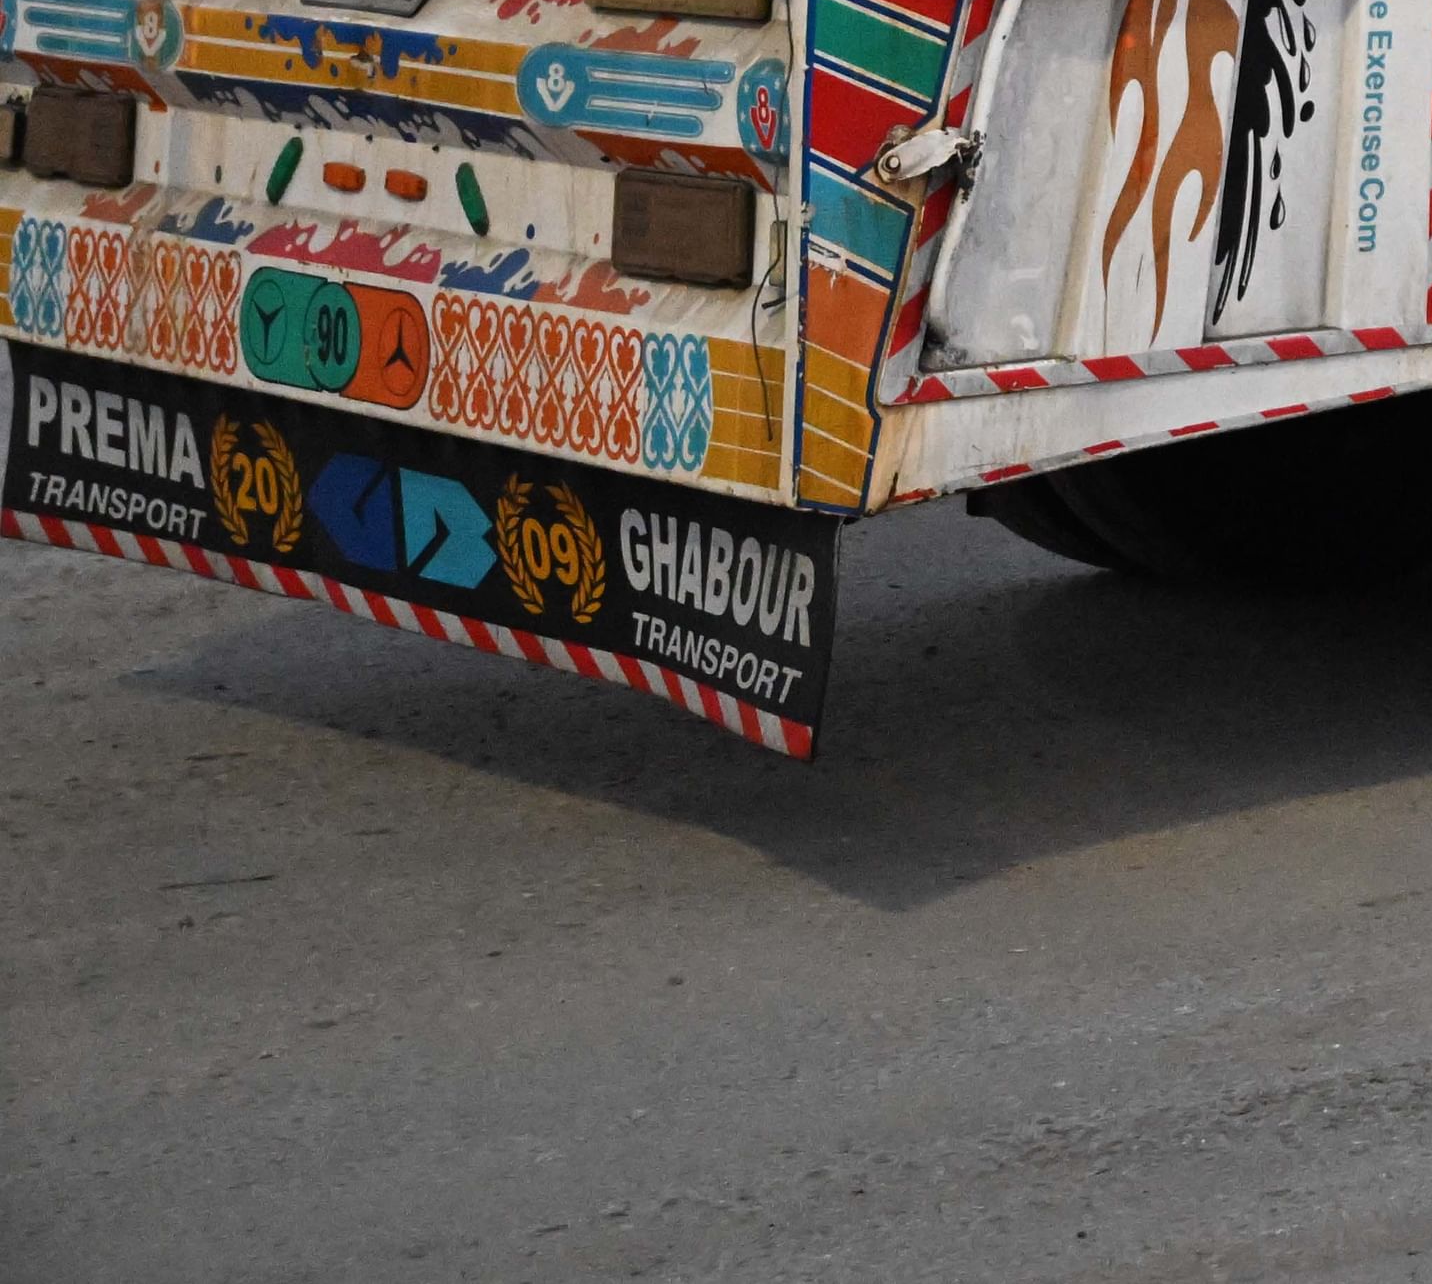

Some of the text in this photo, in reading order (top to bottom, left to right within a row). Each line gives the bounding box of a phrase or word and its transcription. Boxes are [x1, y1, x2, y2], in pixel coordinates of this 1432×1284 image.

[1360, 29, 1396, 175] Exercise
[1355, 177, 1387, 255] Com
[317, 304, 349, 367] 90
[26, 376, 206, 490] PREMA
[27, 471, 207, 541] TRANSPORT
[230, 450, 281, 517] 20
[520, 520, 581, 585] 09
[619, 506, 815, 648] GHABOUR
[631, 611, 803, 704] TRANSPORT
